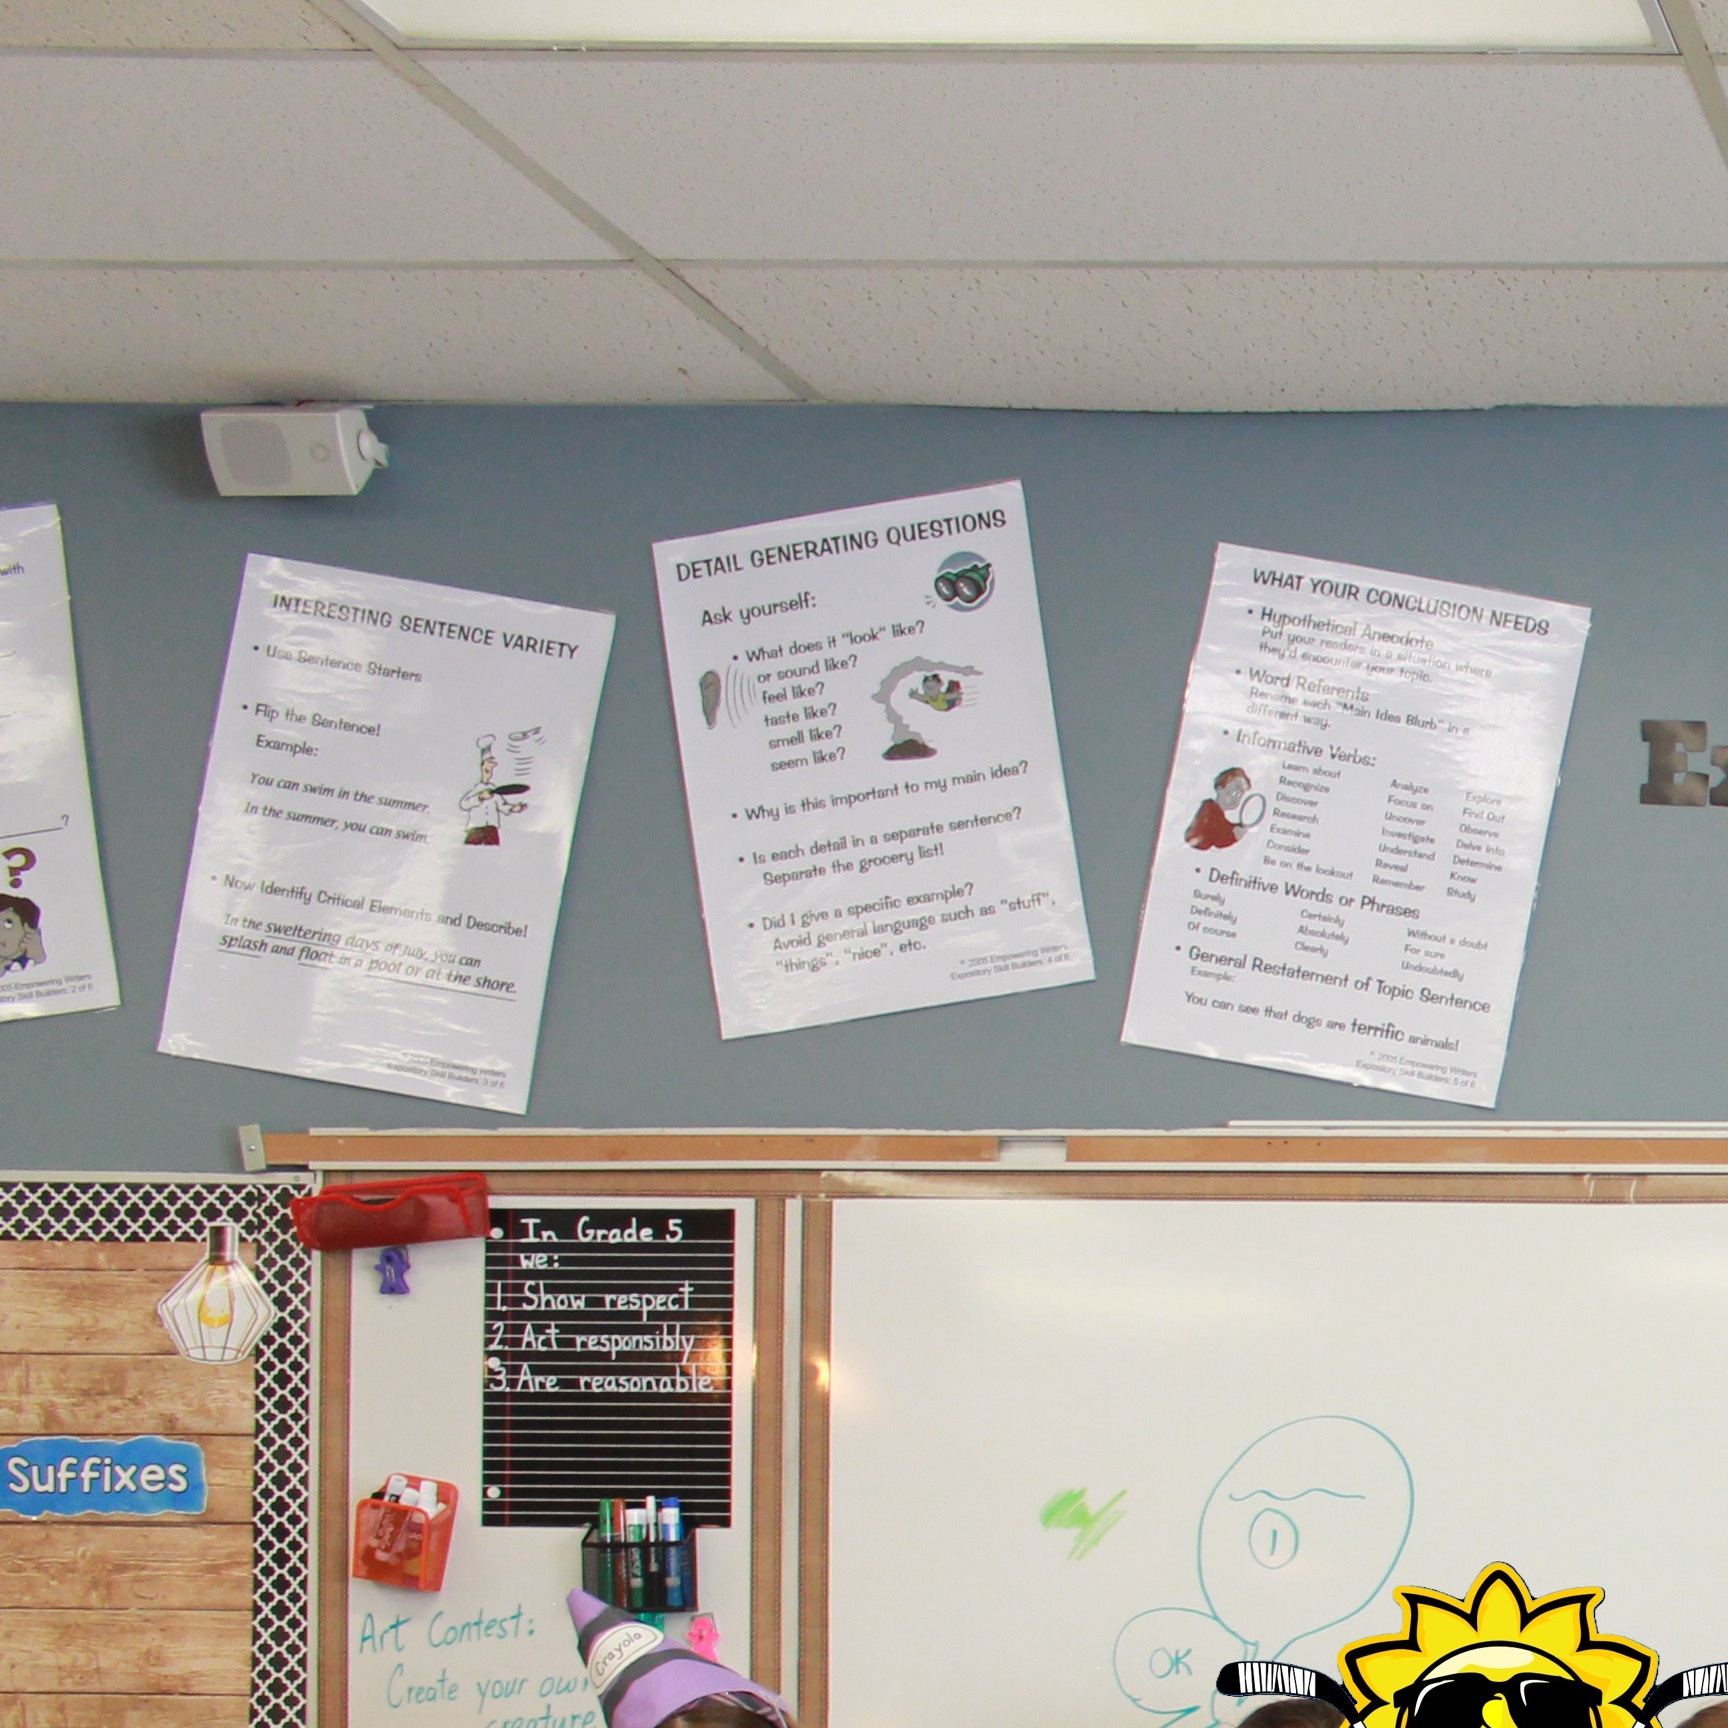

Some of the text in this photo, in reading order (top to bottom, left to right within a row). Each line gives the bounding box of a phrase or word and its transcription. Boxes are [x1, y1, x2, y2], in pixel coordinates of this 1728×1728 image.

[676, 508, 1008, 583] DETAIL GENERATING QUESTIONS
[700, 591, 818, 628] Ask yourself:
[1252, 568, 1550, 636] WHAT YOUR CONCLUSION NEEDS
[272, 593, 580, 662] INTERESTING SENTENCE VARIETY
[745, 643, 784, 663] What
[788, 636, 824, 656] does
[827, 634, 837, 651] it
[891, 619, 926, 640] like?
[255, 702, 382, 738] Flip the Sentence!
[255, 734, 320, 760] Example:
[1208, 866, 1421, 921] Definitive Words or Phrases
[1188, 944, 1491, 1014] General Restatement of Topic Sentence
[519, 1216, 684, 1244] In Grade 5
[519, 1250, 561, 1270] we:
[494, 1281, 695, 1322] 1. Show respect
[488, 1322, 696, 1364] 2. Act responsibly
[489, 1363, 714, 1394] 3. Are reasonable
[7, 1456, 189, 1494] Suffixes
[358, 1603, 536, 1655] Art Contest:
[595, 1632, 642, 1677] Crayola
[1149, 1646, 1194, 1680] OK
[385, 1662, 529, 1714] Create your
